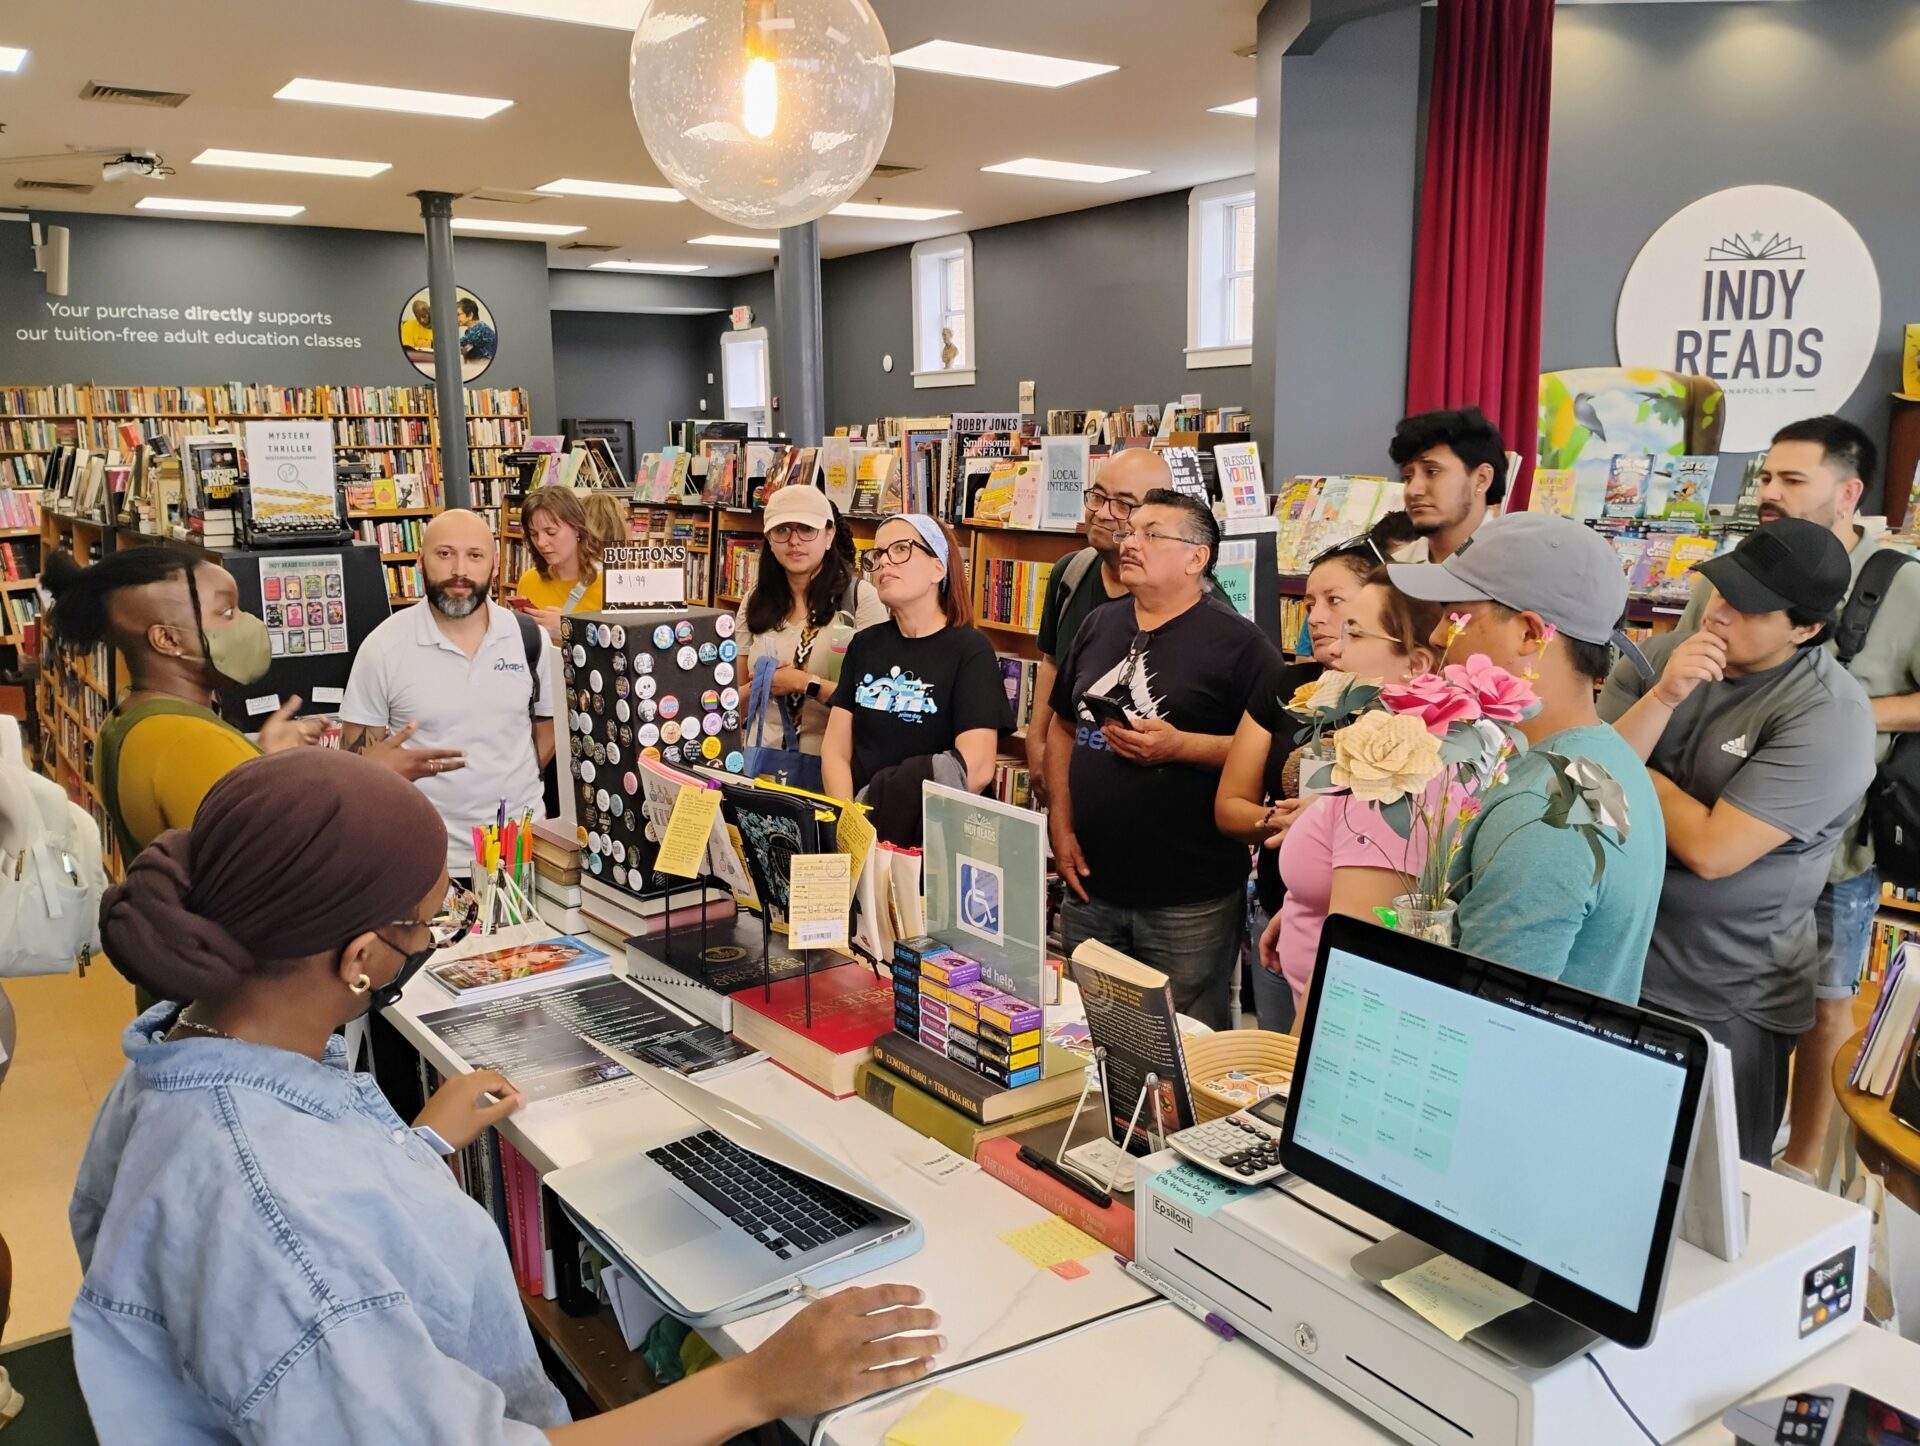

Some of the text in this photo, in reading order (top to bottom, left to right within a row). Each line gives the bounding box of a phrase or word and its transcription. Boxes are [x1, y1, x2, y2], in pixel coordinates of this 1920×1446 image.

[1702, 269, 1805, 321] INDY
[46, 302, 332, 326] Your purchase directly supports
[15, 326, 362, 348] our tuition-free adult education classes
[1675, 327, 1824, 379] READS
[957, 418, 1018, 431] BOBBY JONES
[268, 432, 310, 440] MYSTERY
[963, 437, 1015, 448] Smithsonian
[1223, 455, 1253, 467] BLESSED
[1052, 470, 1078, 480] LOCAL
[1227, 466, 1256, 482] YOUTH
[1047, 482, 1084, 492] INTEREST
[604, 546, 685, 563] BUTTONS
[1509, 997, 1525, 1008] Printer
[1530, 1004, 1549, 1016] Scanner
[1554, 1012, 1577, 1025] Customer
[1578, 1020, 1596, 1033] Display
[1612, 1032, 1632, 1044] devices
[1657, 1046, 1667, 1055] PM
[934, 1080, 949, 1098] WELL
[950, 1089, 962, 1105] YOU
